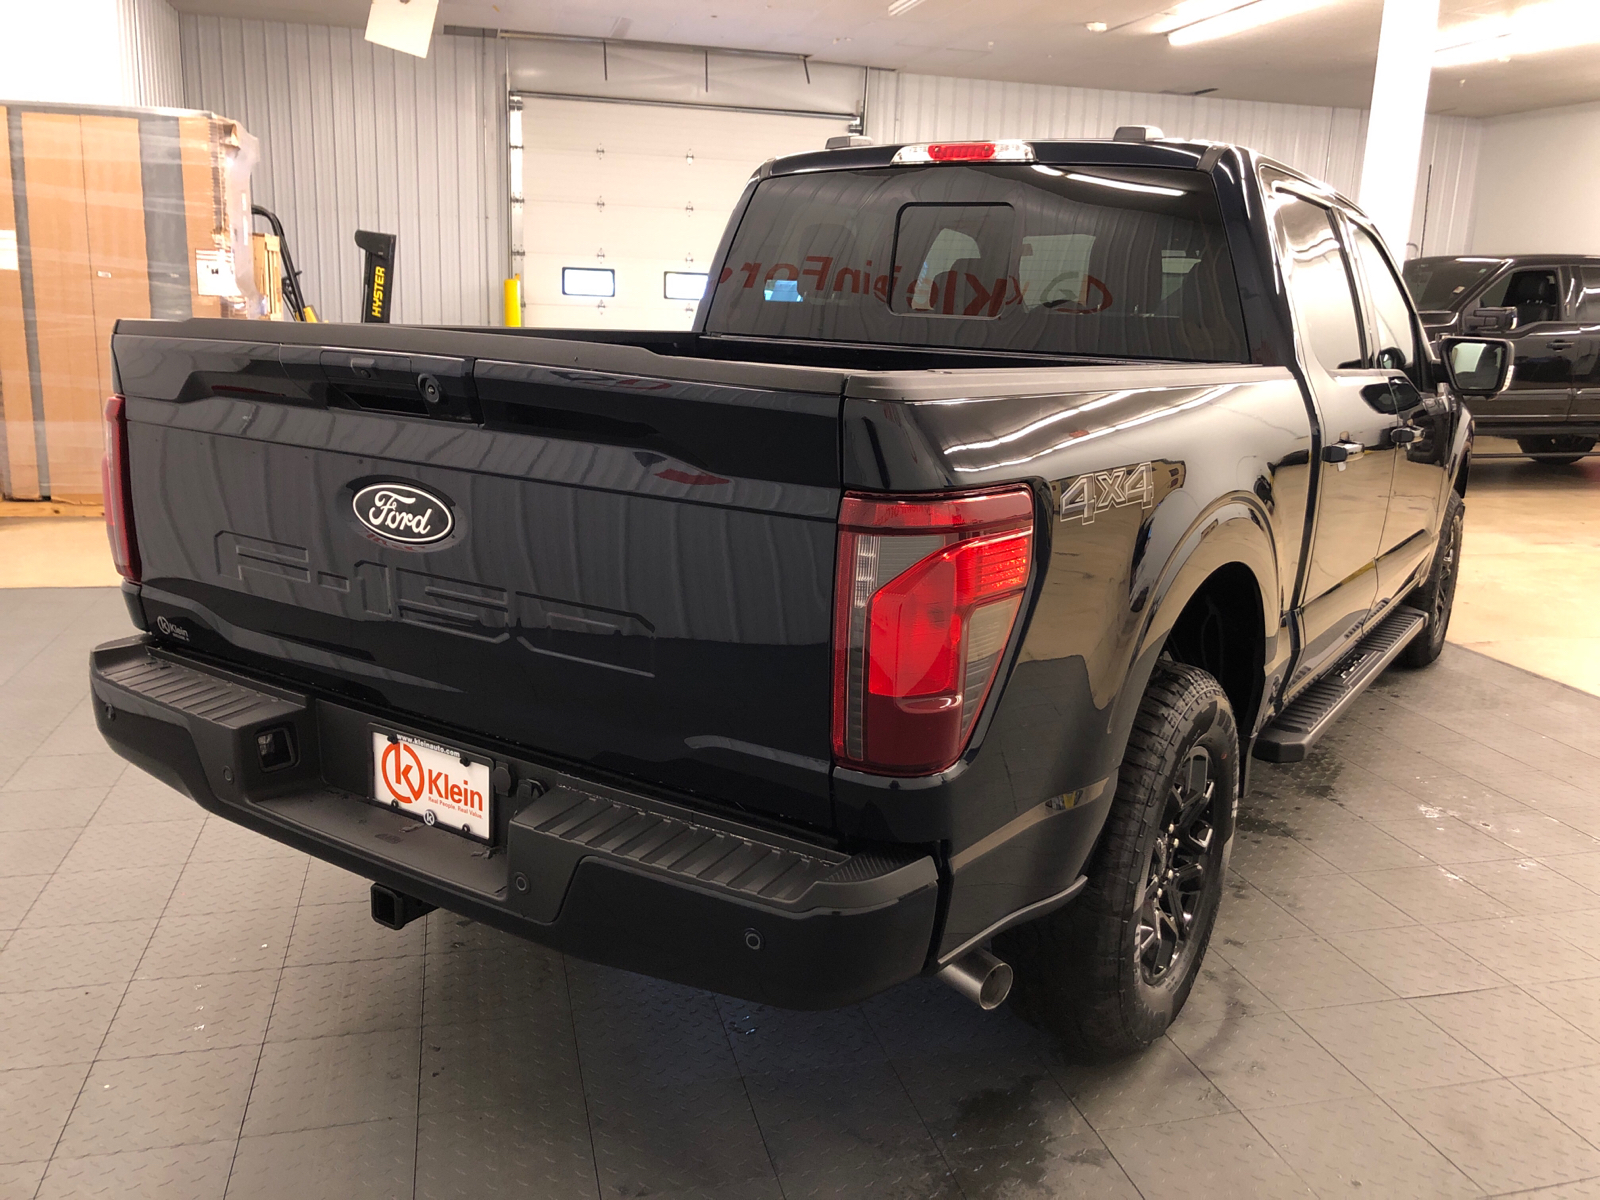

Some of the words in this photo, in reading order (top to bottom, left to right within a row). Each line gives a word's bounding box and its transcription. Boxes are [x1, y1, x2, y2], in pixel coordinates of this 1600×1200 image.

[371, 265, 386, 318] HYSTER
[368, 490, 433, 535] Ford
[214, 529, 656, 678] F-150
[396, 733, 461, 759] www.kleinauto.com
[427, 768, 484, 812] Klein
[428, 796, 438, 805] Real
[439, 799, 456, 811] People.
[457, 805, 469, 814] Real
[469, 809, 484, 820] Value.
